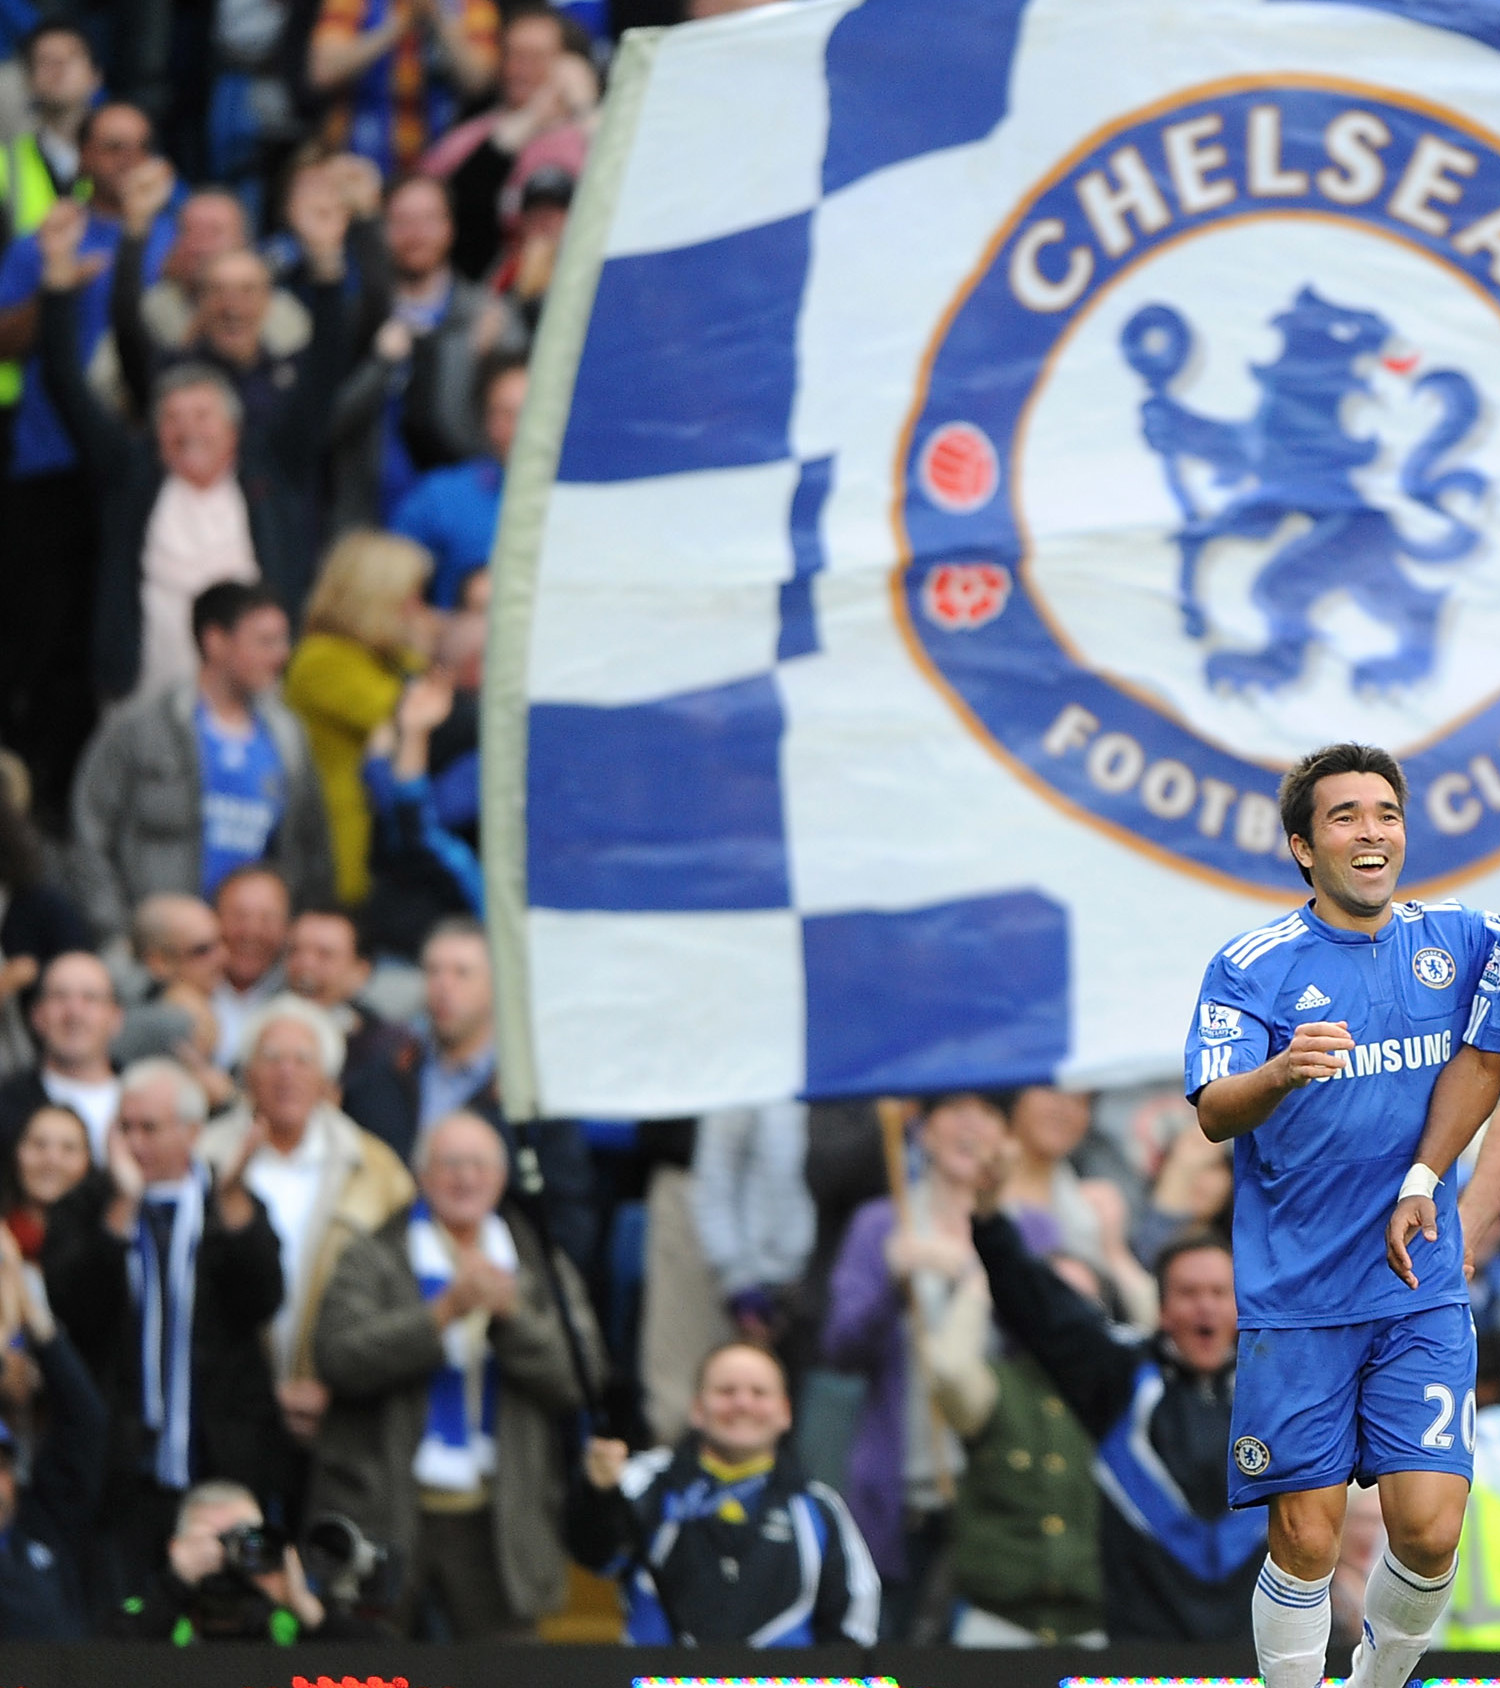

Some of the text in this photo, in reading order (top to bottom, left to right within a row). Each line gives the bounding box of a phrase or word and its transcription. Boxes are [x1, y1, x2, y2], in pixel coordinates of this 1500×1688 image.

[1041, 704, 1291, 861] FOOTB
[1295, 996, 1331, 1011] adidas
[1421, 1383, 1476, 1454] 20
